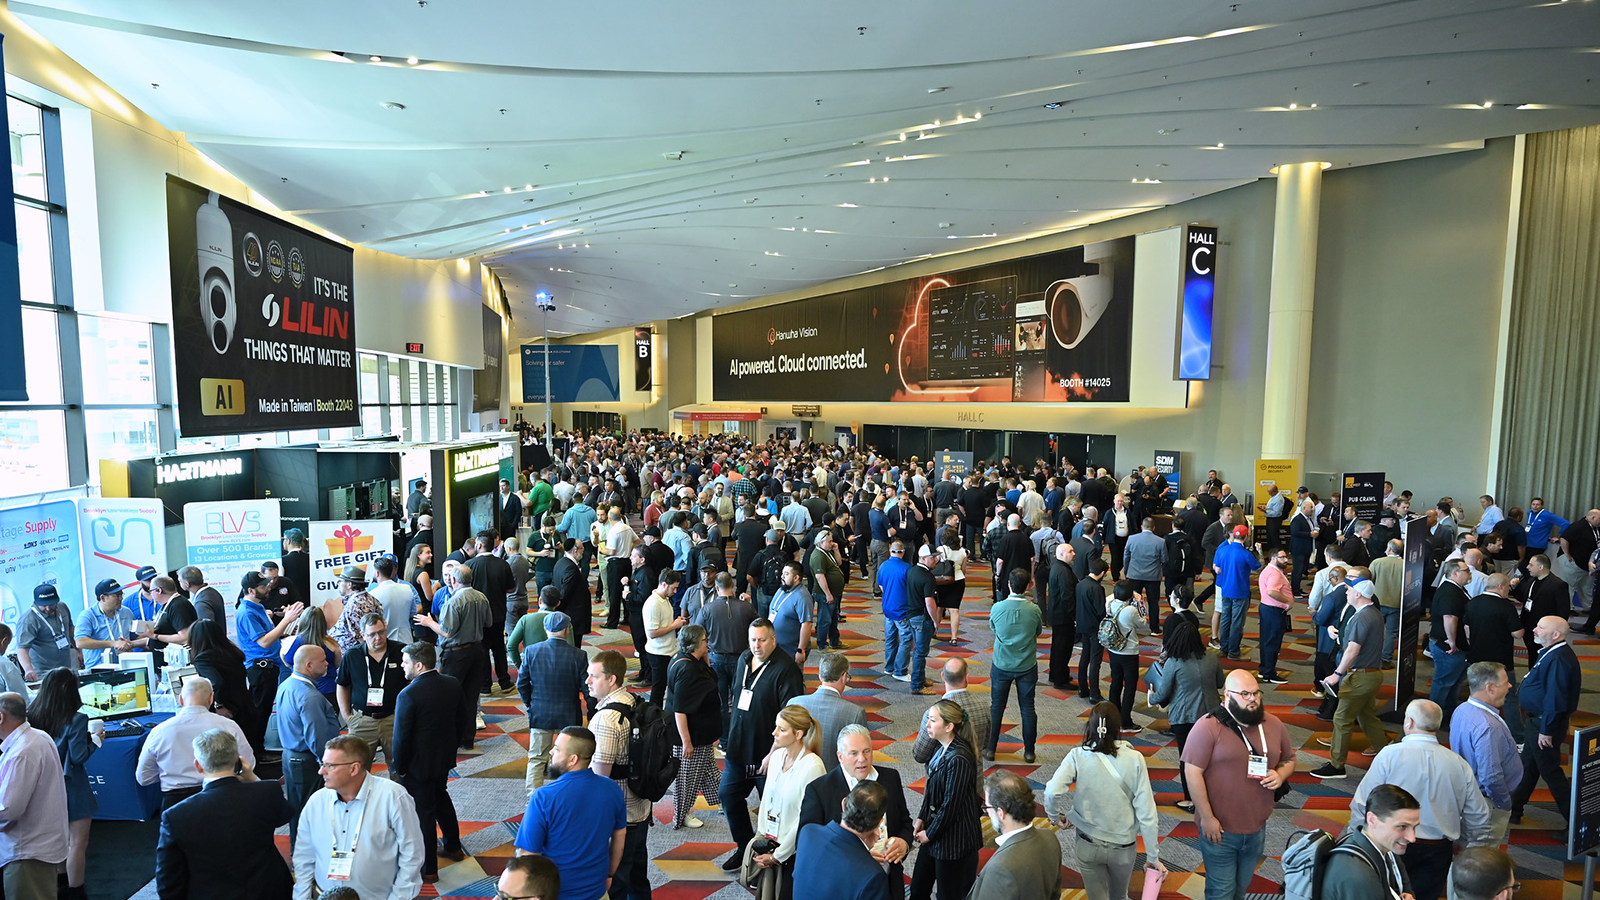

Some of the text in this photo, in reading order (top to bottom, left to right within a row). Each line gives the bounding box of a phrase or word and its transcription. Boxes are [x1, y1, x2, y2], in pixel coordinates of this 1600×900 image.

[1189, 232, 1215, 245] HALL
[1191, 246, 1211, 275] C
[313, 276, 349, 302] IT'S THE
[282, 296, 349, 340] LILIN
[775, 327, 818, 341] Hanwha Vision
[243, 338, 352, 368] THINGS THAT MATTER
[409, 343, 421, 352] EXIT
[638, 345, 648, 358] B
[729, 348, 868, 379] AI powered. Cloud connected.
[1060, 377, 1111, 388] BOOTH #14025
[215, 384, 233, 410] AI
[258, 398, 354, 413] Made in Taiwan Booth 22043
[957, 411, 985, 423] HALL C
[454, 446, 499, 474] HARTMANN
[1155, 455, 1174, 466] SDM
[156, 457, 242, 485] HARTMANN
[0, 517, 57, 540] tage Supply
[205, 509, 262, 534] BLVS
[196, 543, 273, 555] Over 500 Brands
[203, 554, 239, 562] Locations
[246, 551, 277, 559] Growing
[315, 549, 386, 570] FREE GIFT
